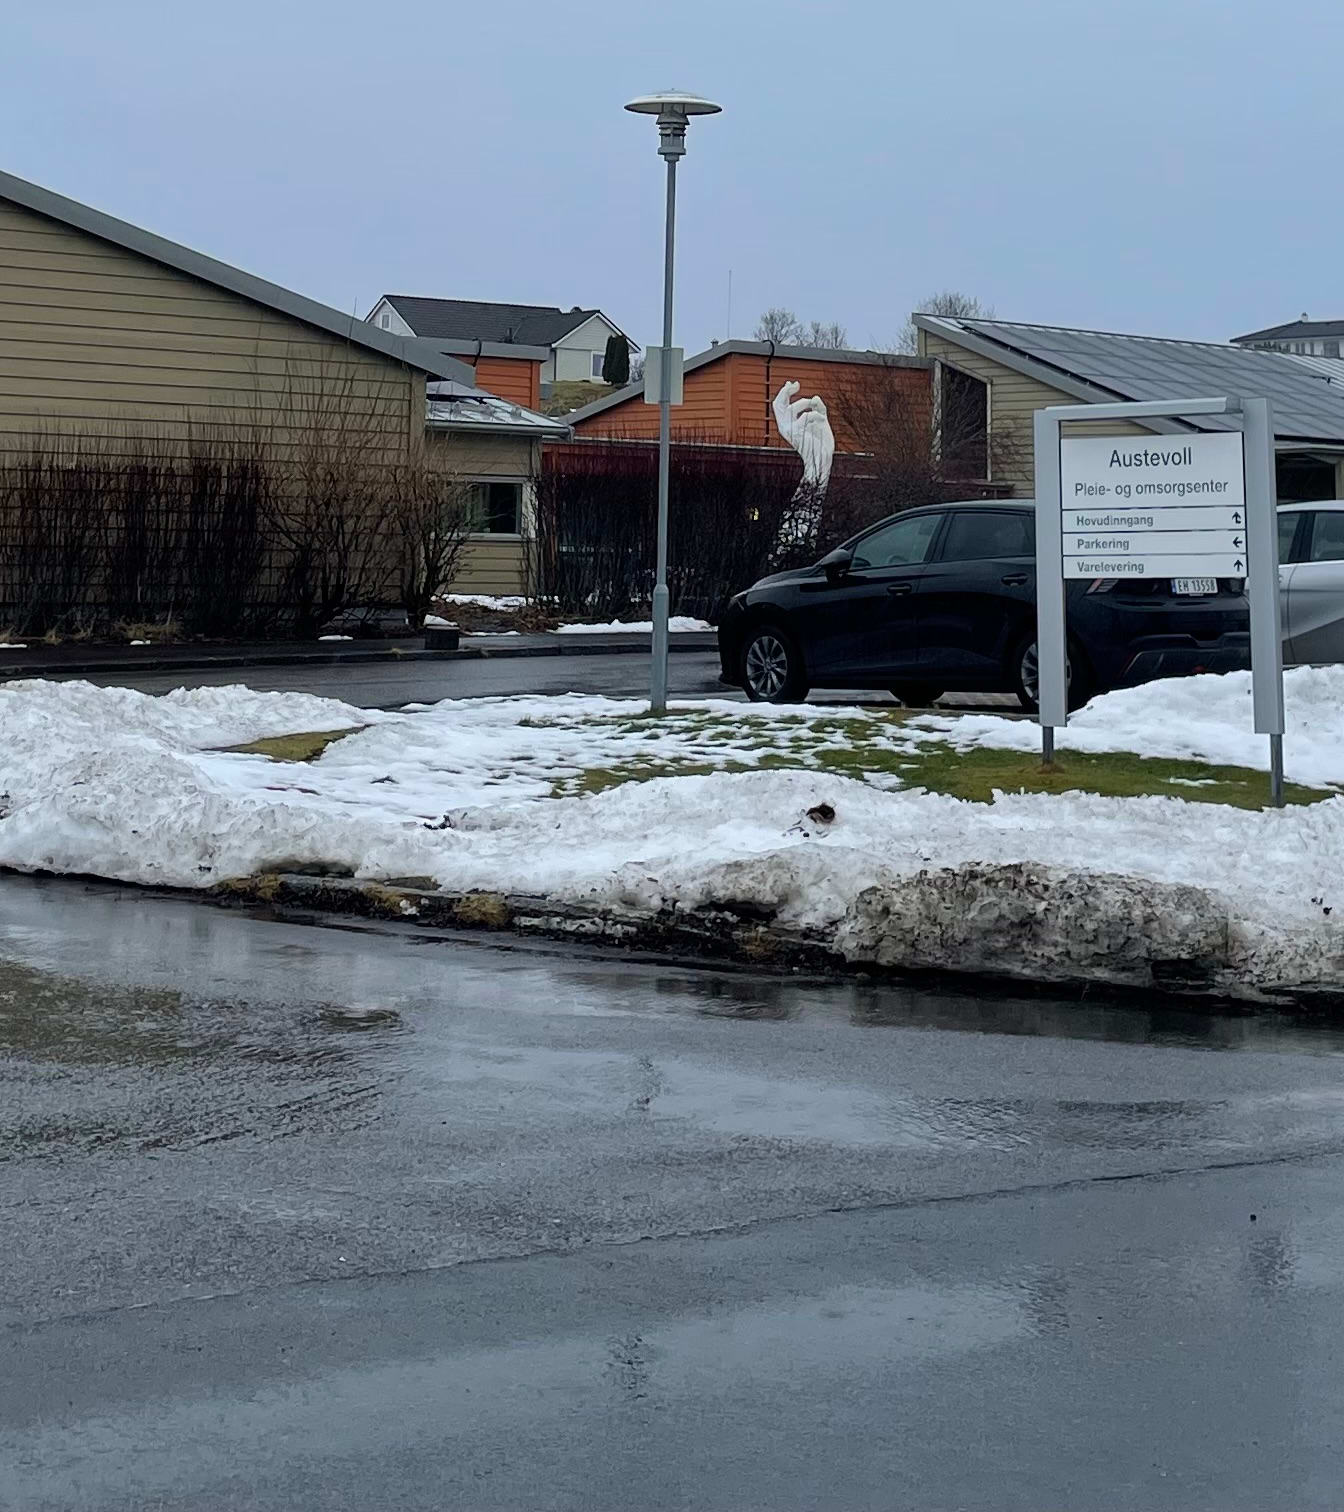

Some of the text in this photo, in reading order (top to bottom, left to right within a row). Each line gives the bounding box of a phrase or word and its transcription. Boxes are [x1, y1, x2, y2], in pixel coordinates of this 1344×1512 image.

[1109, 446, 1192, 468] Austevoll
[1074, 479, 1229, 498] Pleie- og omsorgsenter
[1076, 515, 1154, 528] Hovudinngang
[1077, 537, 1130, 551] Parkering
[1077, 561, 1145, 574] Varelevering
